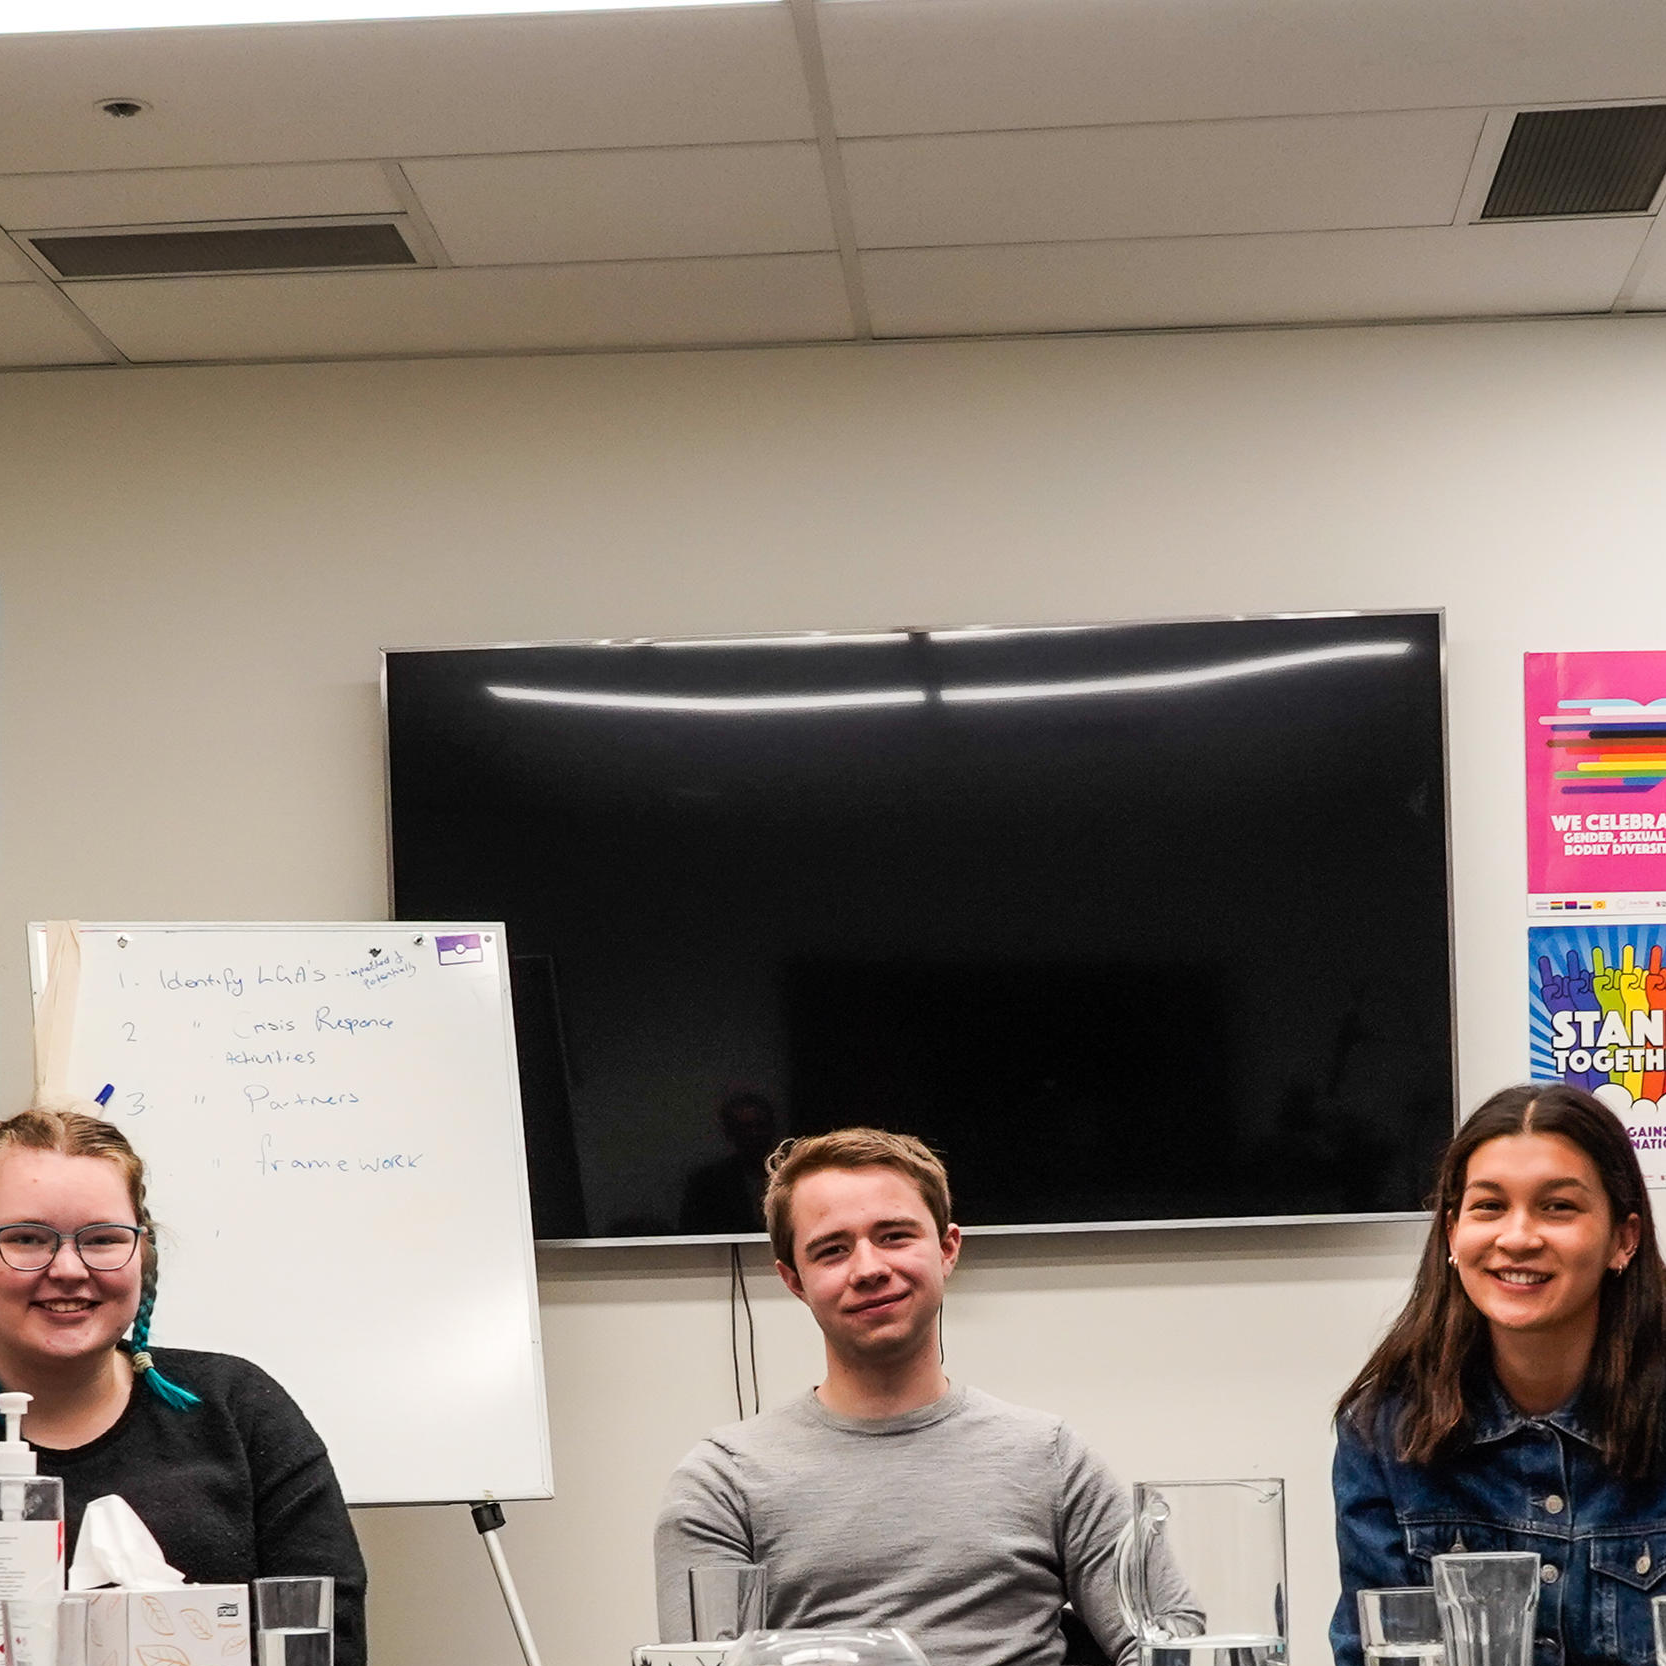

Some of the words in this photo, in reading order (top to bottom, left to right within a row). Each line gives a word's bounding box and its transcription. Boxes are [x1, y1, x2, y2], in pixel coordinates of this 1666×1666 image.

[1550, 814, 1582, 831] WE
[1563, 831, 1618, 843] GENDER,
[1619, 830, 1666, 842] SEXUAL
[1564, 844, 1611, 856] BODILY
[159, 968, 243, 996] Identify
[243, 1084, 360, 1112] Partners
